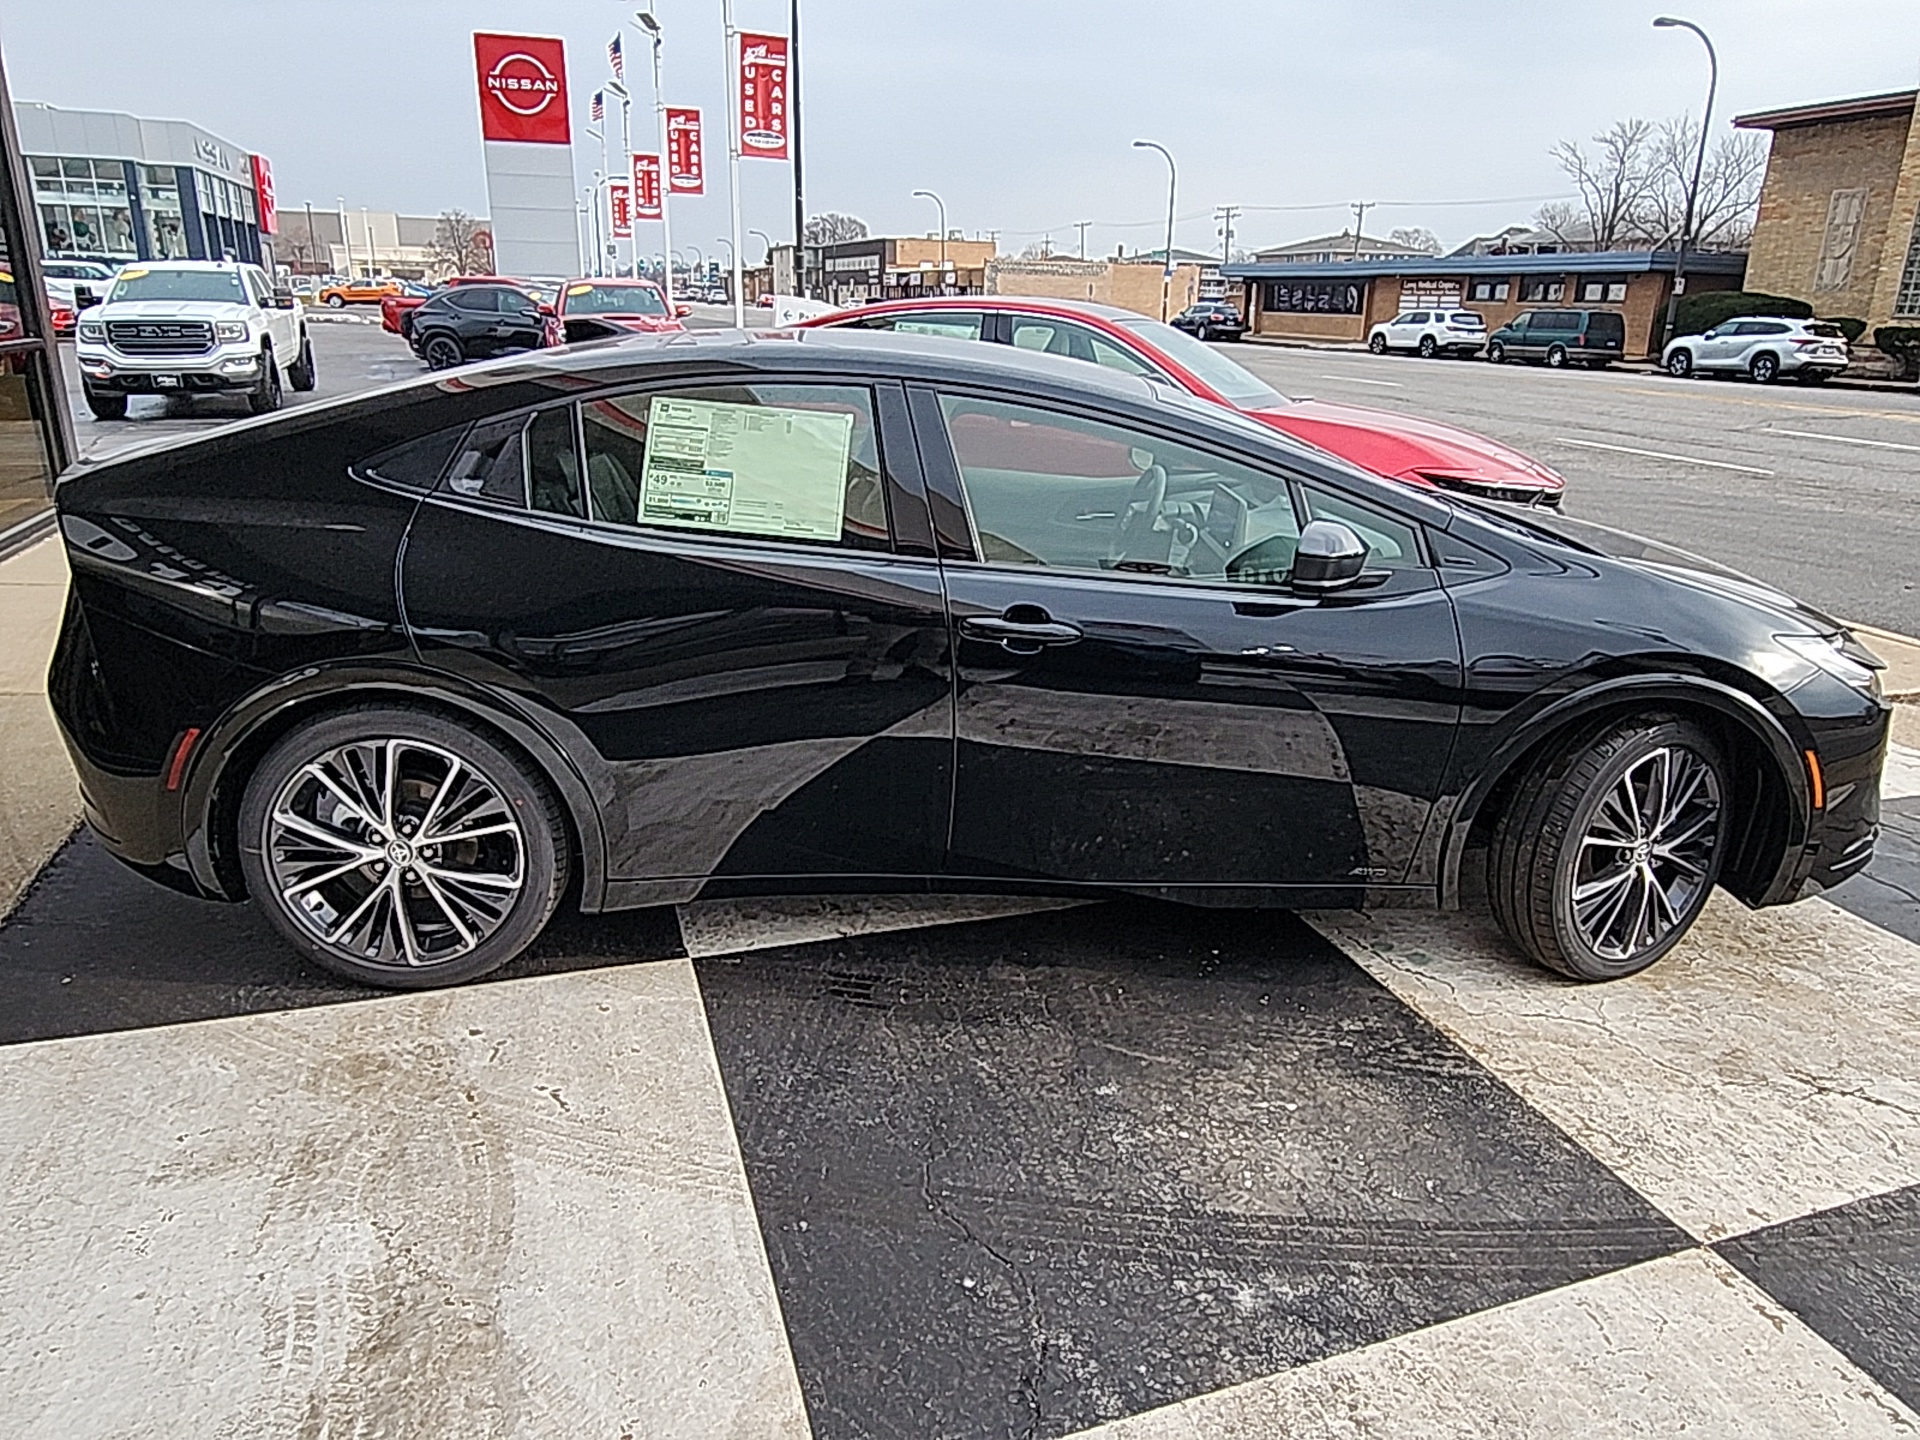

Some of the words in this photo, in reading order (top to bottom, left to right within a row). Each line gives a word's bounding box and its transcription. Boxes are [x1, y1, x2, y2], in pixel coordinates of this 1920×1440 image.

[487, 76, 558, 92] NISSAN
[744, 66, 757, 128] USED
[771, 69, 783, 131] CARS
[670, 130, 681, 174] USED
[689, 131, 699, 175] CARS
[653, 475, 668, 485] 49
